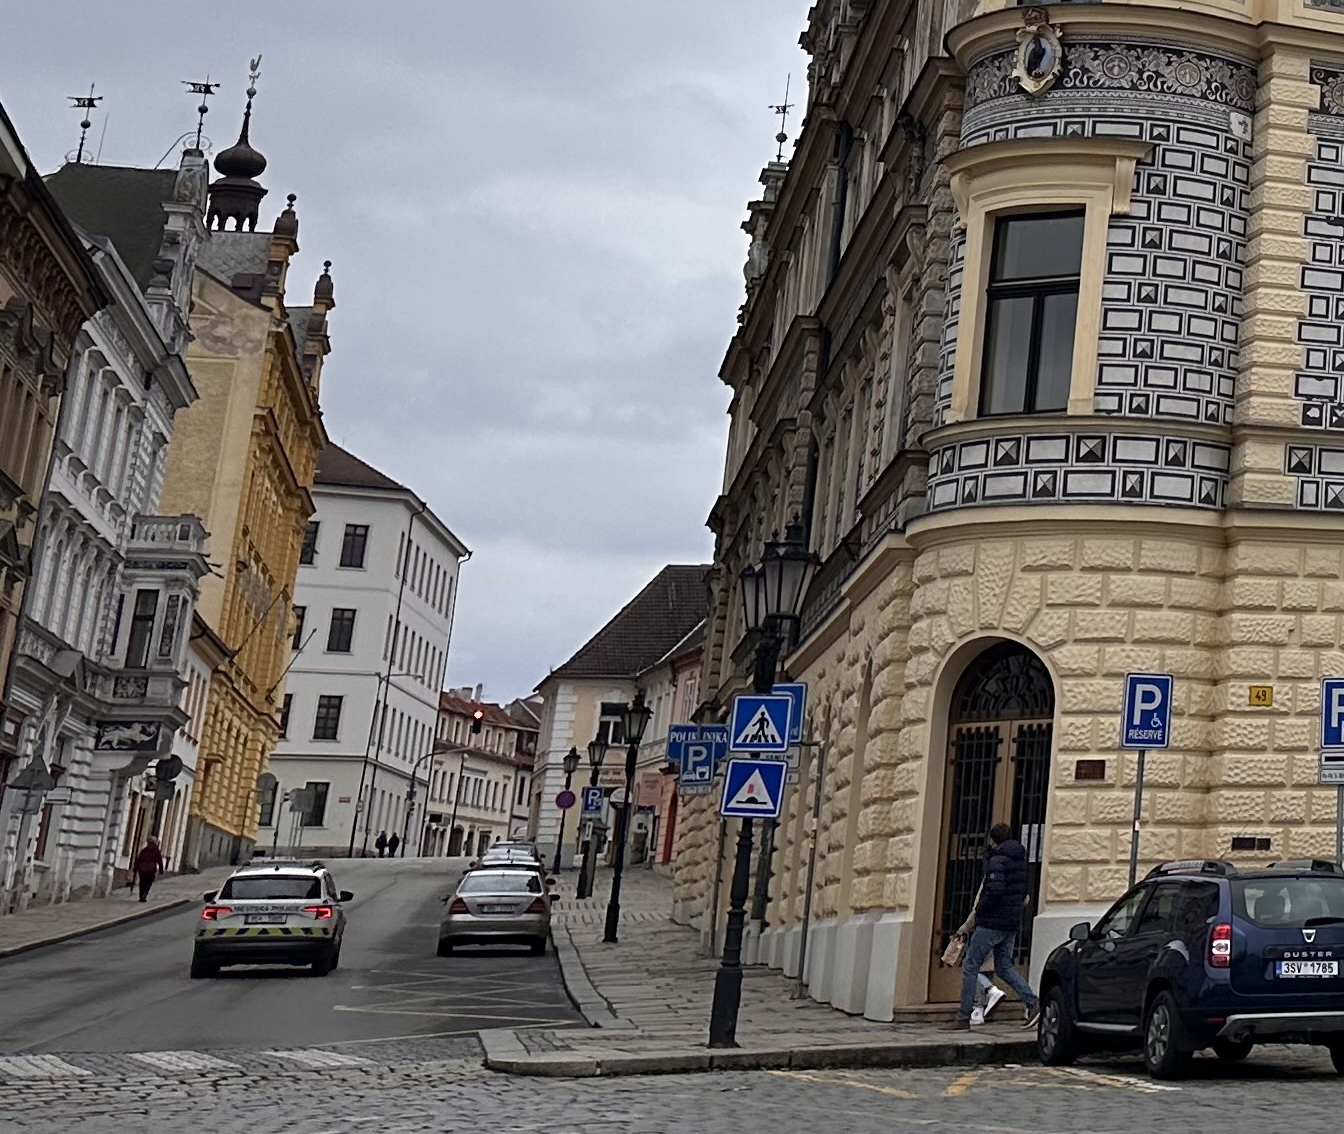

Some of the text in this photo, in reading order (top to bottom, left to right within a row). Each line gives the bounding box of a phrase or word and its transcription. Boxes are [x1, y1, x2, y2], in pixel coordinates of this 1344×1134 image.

[1255, 690, 1267, 702] 49
[1132, 684, 1162, 725] P
[688, 746, 708, 770] P
[1284, 951, 1333, 959] DUSTER
[1284, 962, 1334, 974] 3SV 1785
